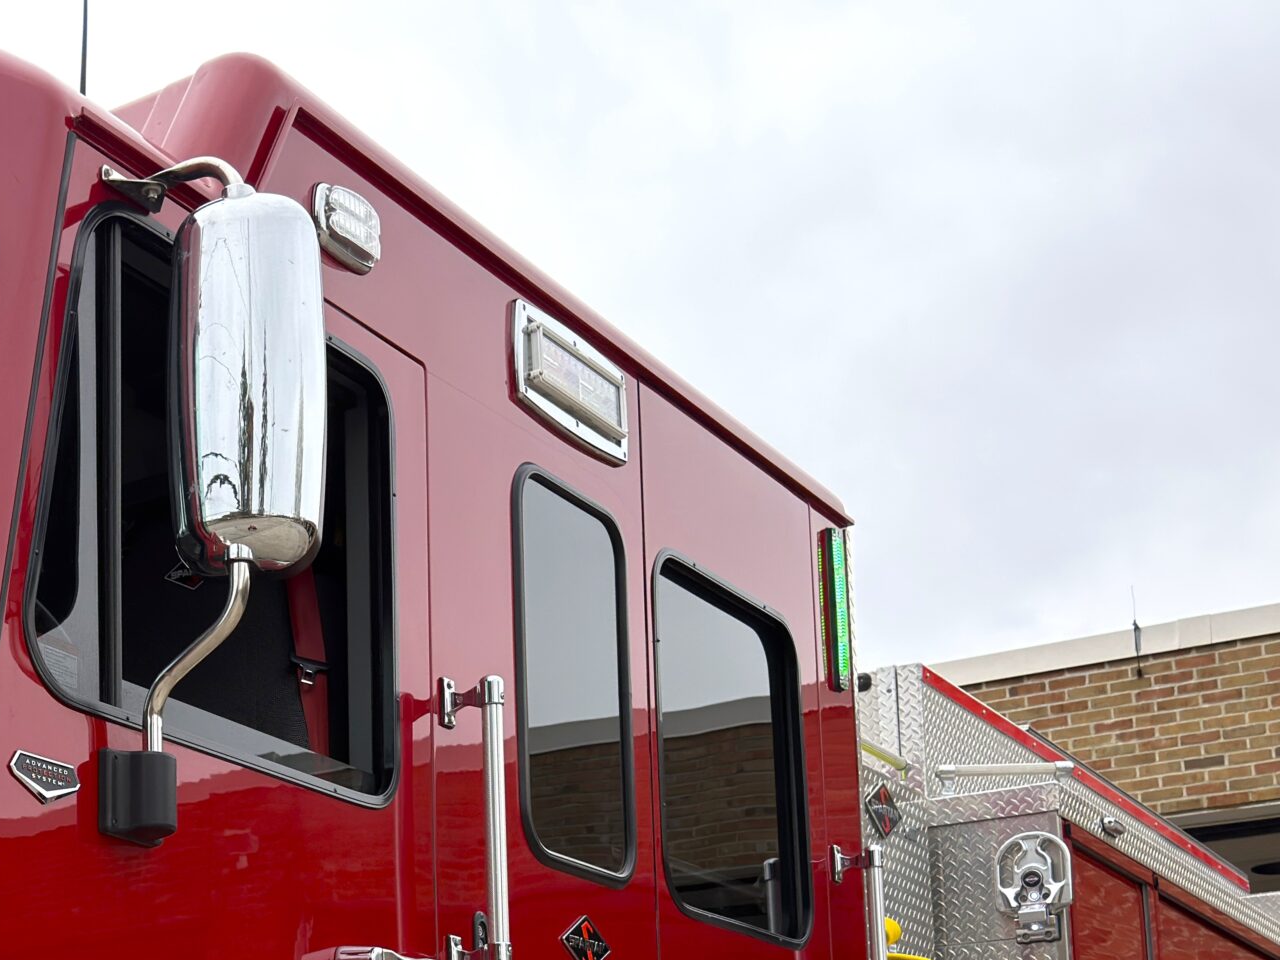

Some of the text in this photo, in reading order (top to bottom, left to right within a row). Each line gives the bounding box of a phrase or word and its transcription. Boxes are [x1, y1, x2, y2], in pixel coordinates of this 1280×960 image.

[22, 763, 73, 784] PROTECTION
[25, 758, 69, 775] ADVANCED
[31, 773, 64, 786] SYSTEM
